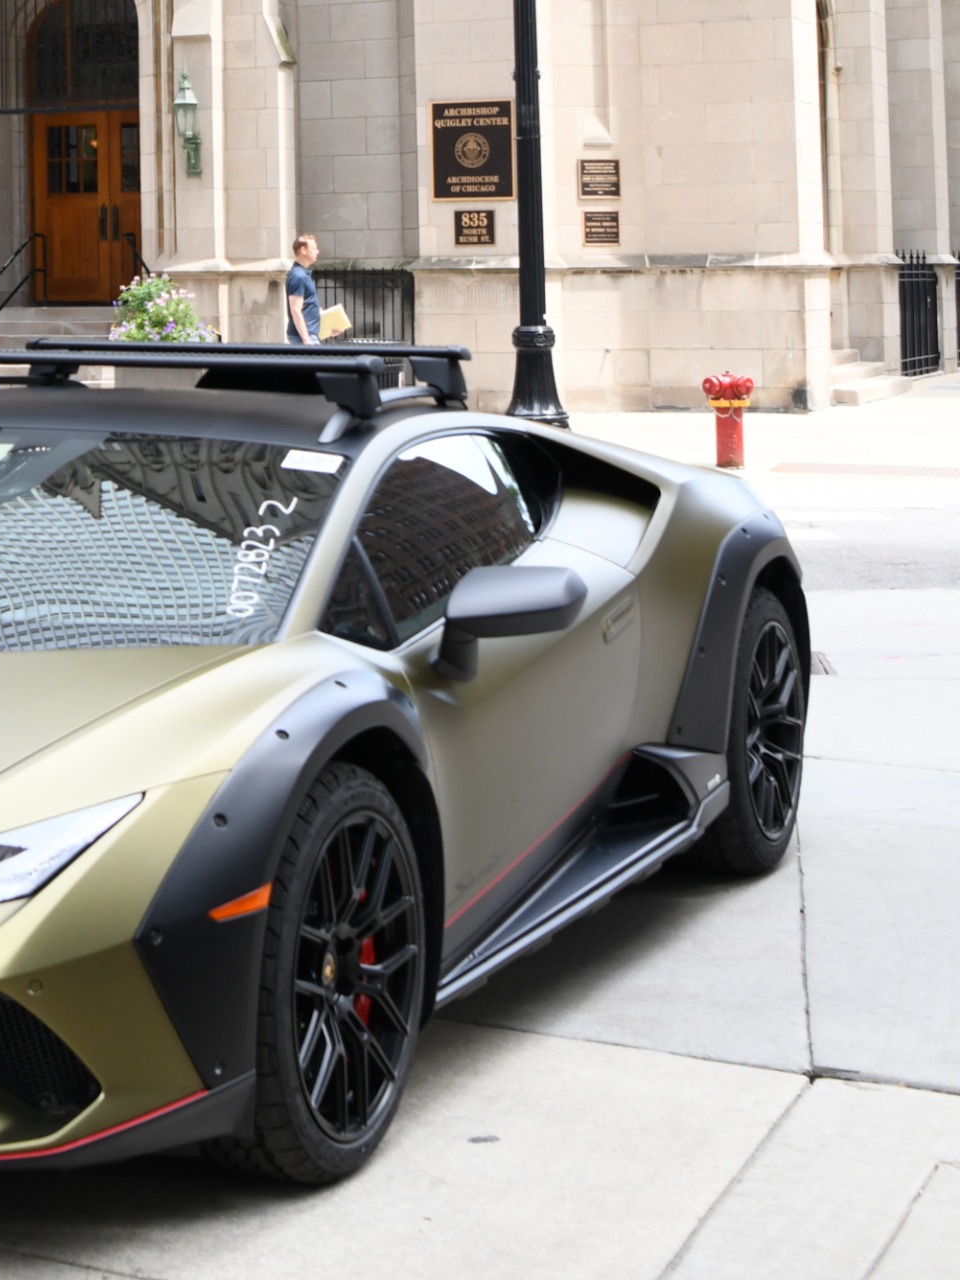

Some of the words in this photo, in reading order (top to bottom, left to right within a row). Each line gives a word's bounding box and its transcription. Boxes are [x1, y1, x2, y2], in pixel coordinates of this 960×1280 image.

[443, 107, 499, 117] ARCHBISHOP
[434, 119, 472, 129] QUIGLEY
[473, 117, 509, 126] CENTER
[446, 175, 500, 184] ARCHDIOCESE
[450, 185, 461, 193] OF
[461, 212, 488, 227] 835
[459, 235, 478, 243] RUSH
